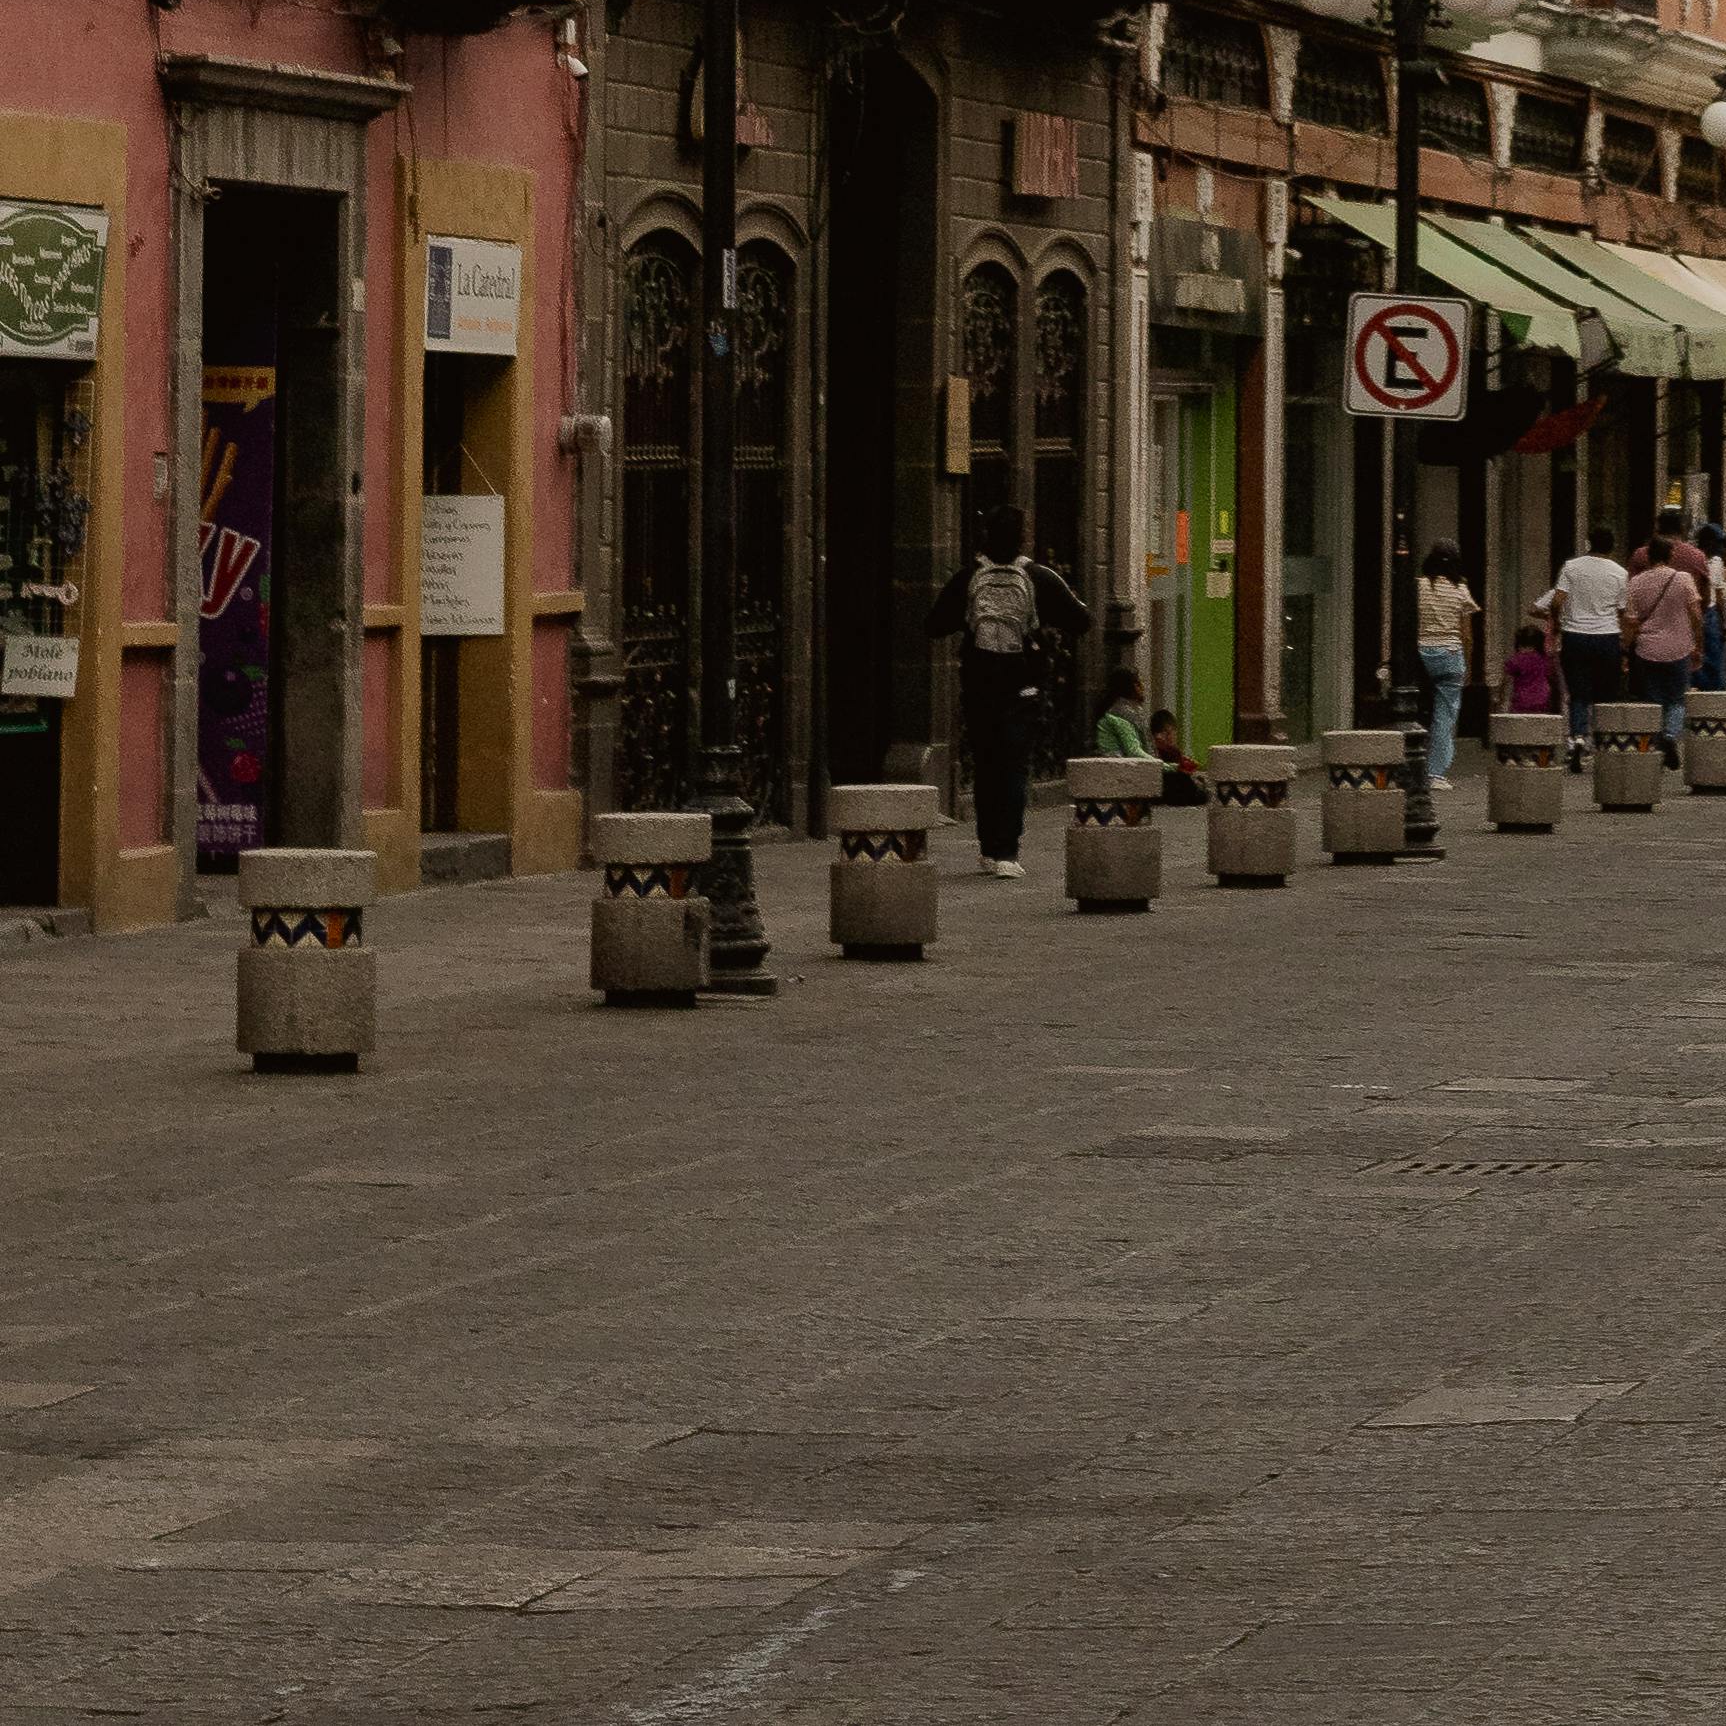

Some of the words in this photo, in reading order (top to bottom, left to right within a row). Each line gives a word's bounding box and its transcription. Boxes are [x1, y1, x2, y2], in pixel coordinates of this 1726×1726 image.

[457, 261, 471, 296] La
[472, 263, 515, 300] Catedral
[1385, 325, 1429, 390] E
[5, 664, 74, 683] poblano
